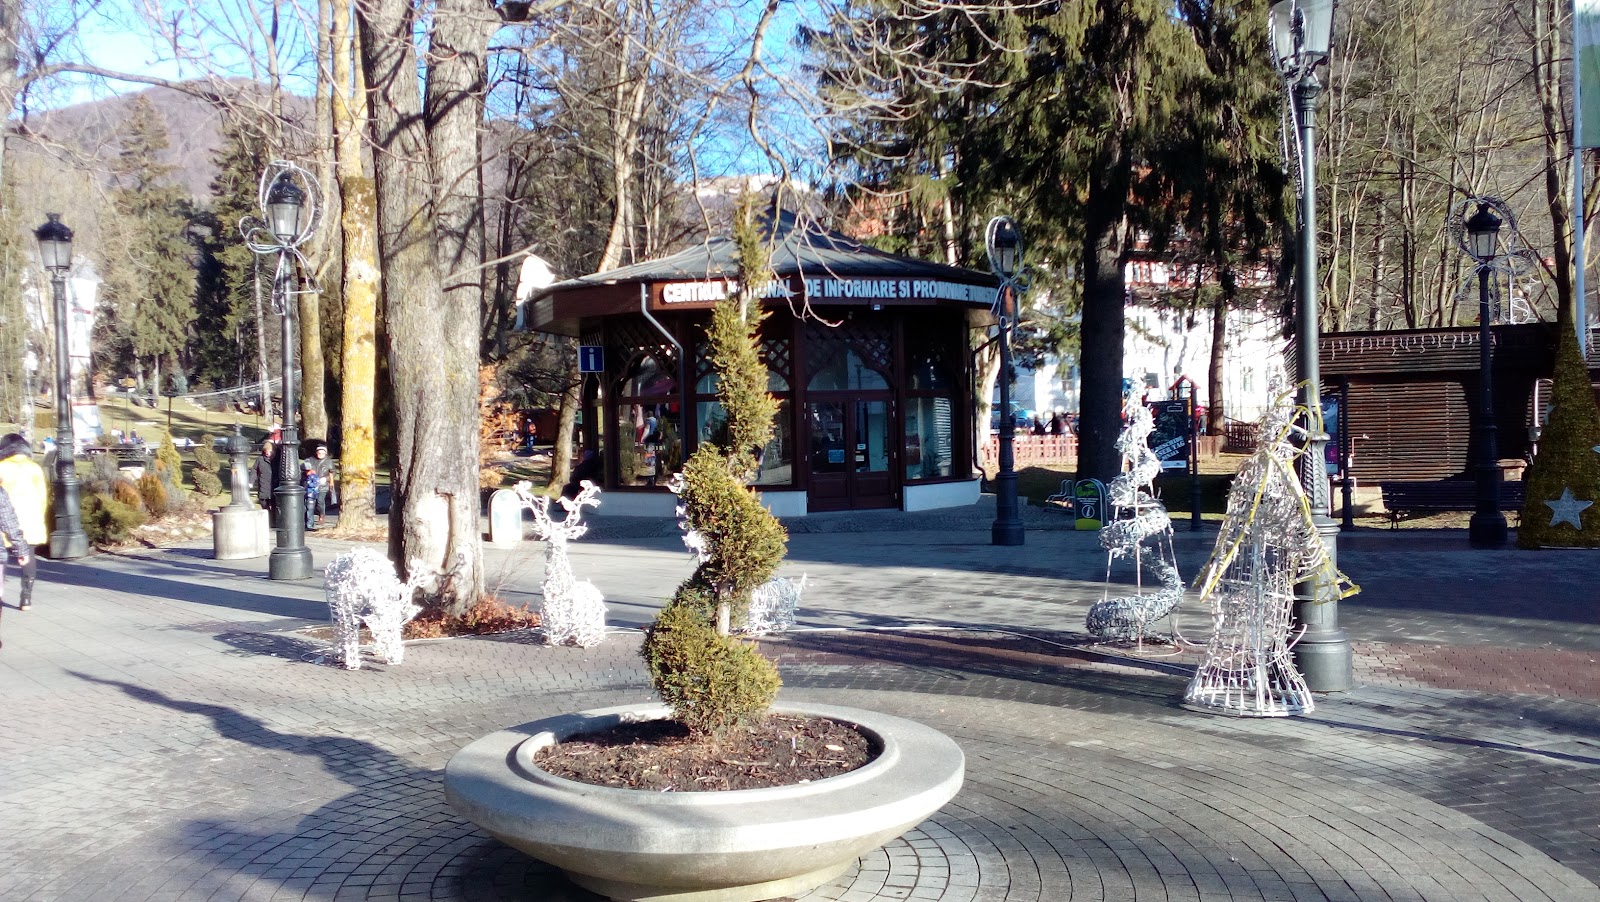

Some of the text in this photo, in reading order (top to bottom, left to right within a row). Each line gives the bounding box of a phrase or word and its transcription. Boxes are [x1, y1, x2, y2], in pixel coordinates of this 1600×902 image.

[663, 281, 726, 303] CENTRUL
[806, 279, 821, 298] DE
[825, 279, 897, 298] INFORMARE
[900, 280, 910, 298] SI
